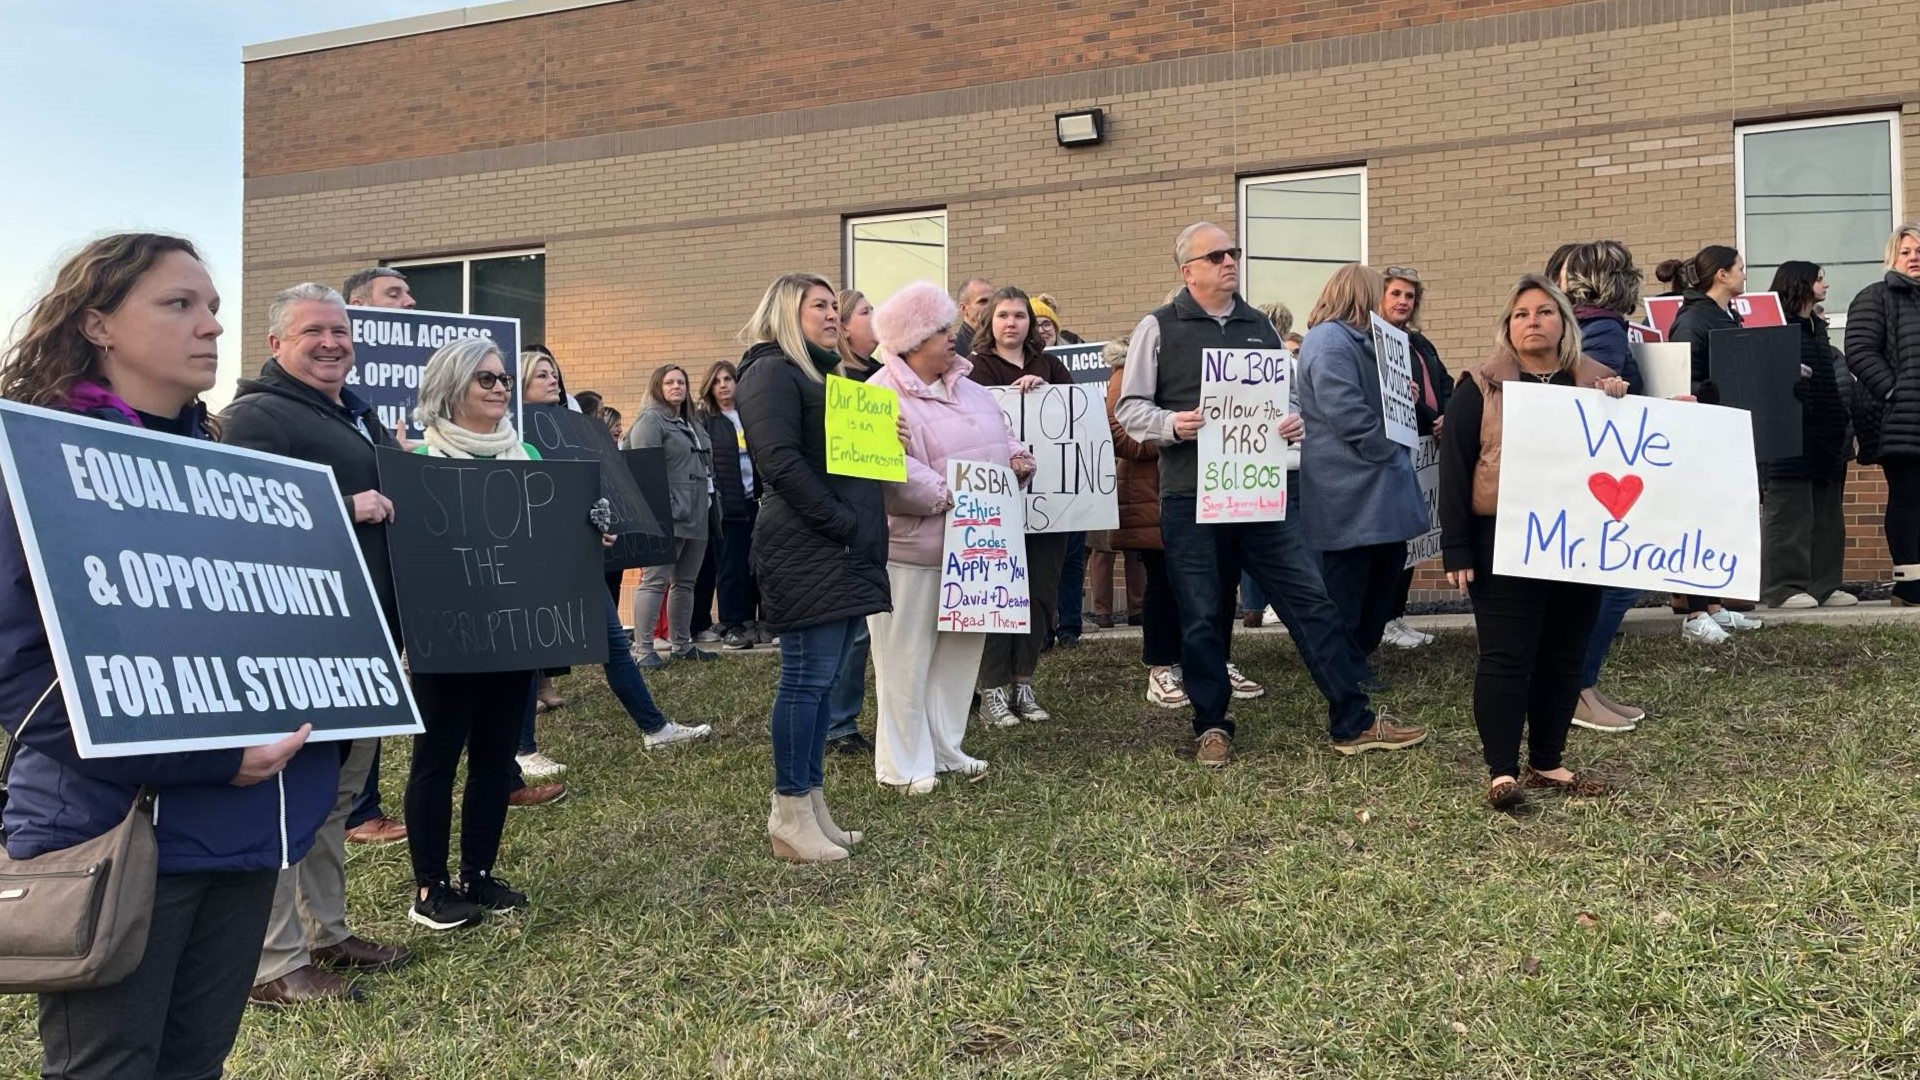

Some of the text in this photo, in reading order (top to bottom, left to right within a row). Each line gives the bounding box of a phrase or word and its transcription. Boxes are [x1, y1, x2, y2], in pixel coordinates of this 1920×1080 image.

[352, 318, 414, 347] EQUAL
[1071, 351, 1112, 372] ACCE
[1205, 350, 1284, 386] NC BOE
[1385, 332, 1406, 370] OUR
[364, 361, 426, 389] OPPO
[829, 379, 893, 420] Our Board
[1201, 395, 1284, 420] Follow the
[847, 418, 874, 433] is an
[1222, 423, 1268, 455] KRS
[1574, 398, 1673, 467] We
[954, 462, 1013, 498] KSBA
[1026, 440, 1117, 495] LING
[60, 442, 314, 531] EQUAL ACCESS
[420, 464, 555, 540] STOP
[1202, 495, 1223, 512] Stop
[954, 495, 1001, 521] Ethics
[964, 526, 1007, 549] Codes
[1426, 535, 1440, 558] OU
[1524, 509, 1738, 588] Mr. Bradley
[451, 544, 518, 588] THE
[946, 552, 1025, 583] Apply to You
[83, 549, 351, 618] & OPPORTUNITY
[943, 582, 988, 609] David
[84, 655, 400, 718] FOR ALL STUDENTS
